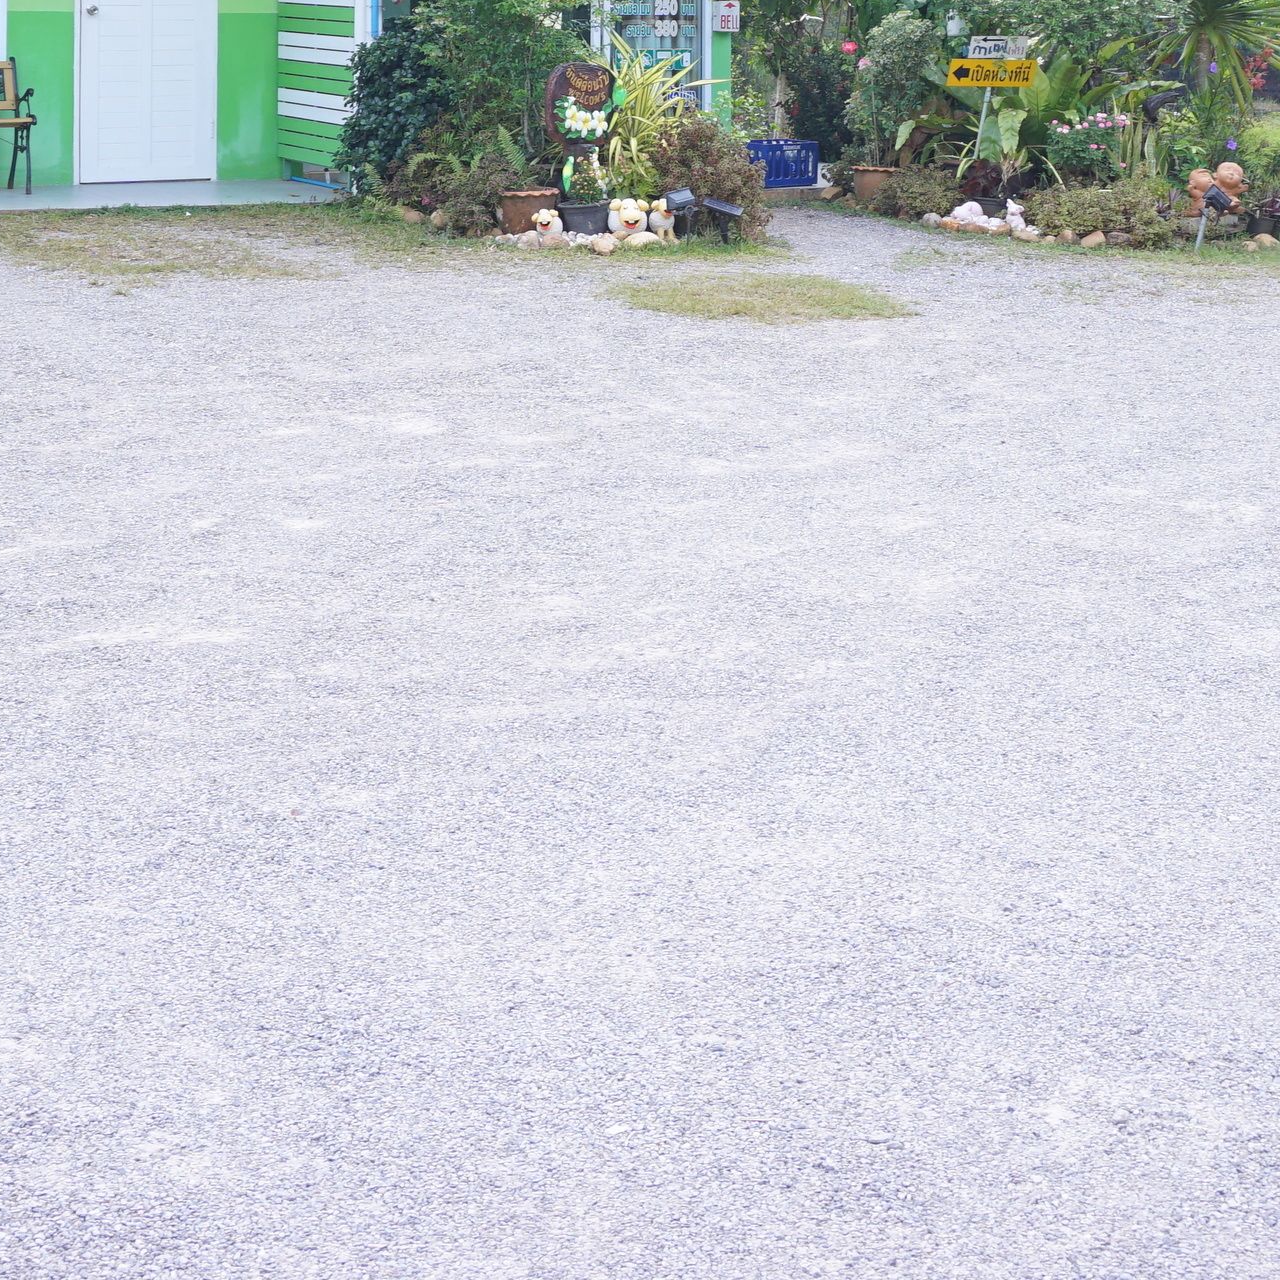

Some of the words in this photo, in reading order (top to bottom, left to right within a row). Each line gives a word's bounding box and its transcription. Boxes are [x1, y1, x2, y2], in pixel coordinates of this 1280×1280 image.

[720, 14, 739, 30] BELL
[970, 62, 1032, 82] เปิดหองที่นี่
